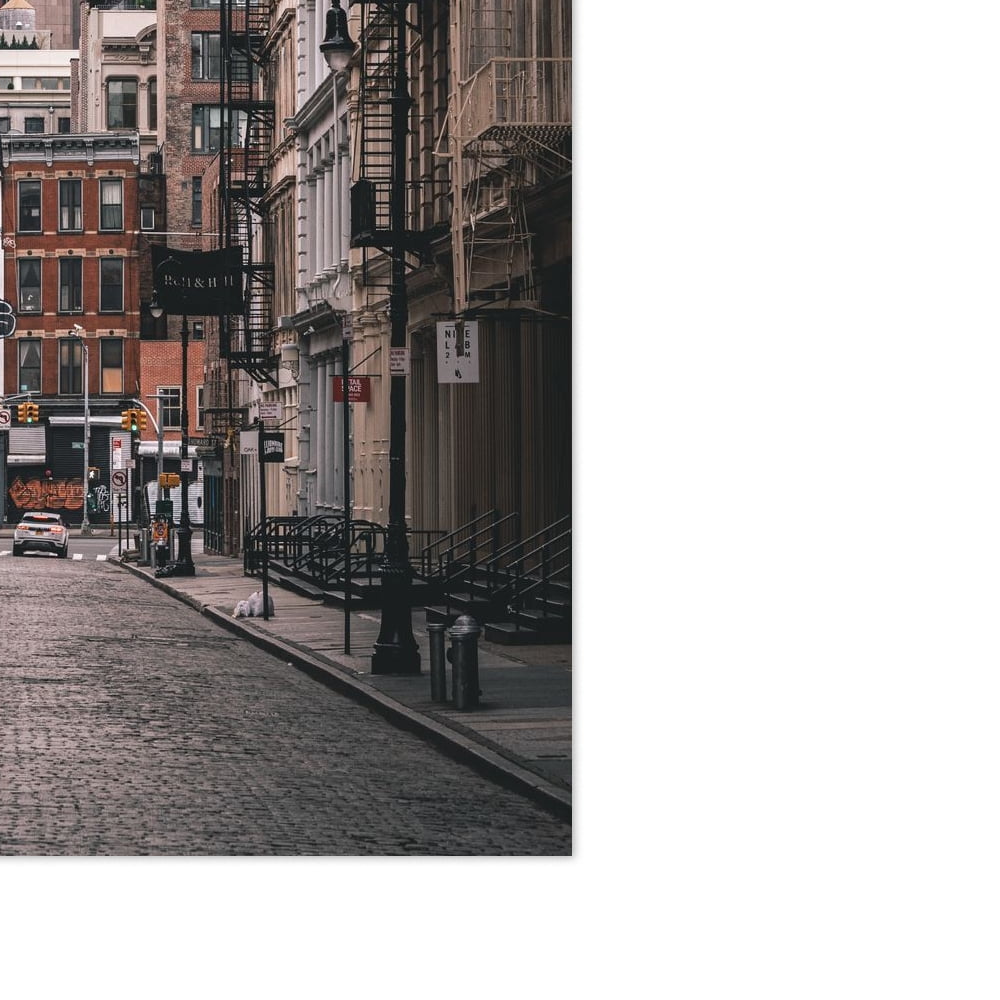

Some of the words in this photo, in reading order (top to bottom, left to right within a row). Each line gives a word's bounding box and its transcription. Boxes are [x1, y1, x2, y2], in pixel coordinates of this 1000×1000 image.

[194, 277, 205, 288] &
[208, 274, 233, 288] Hll
[444, 329, 471, 339] NIE
[445, 340, 471, 350] LB
[445, 351, 471, 359] 2M
